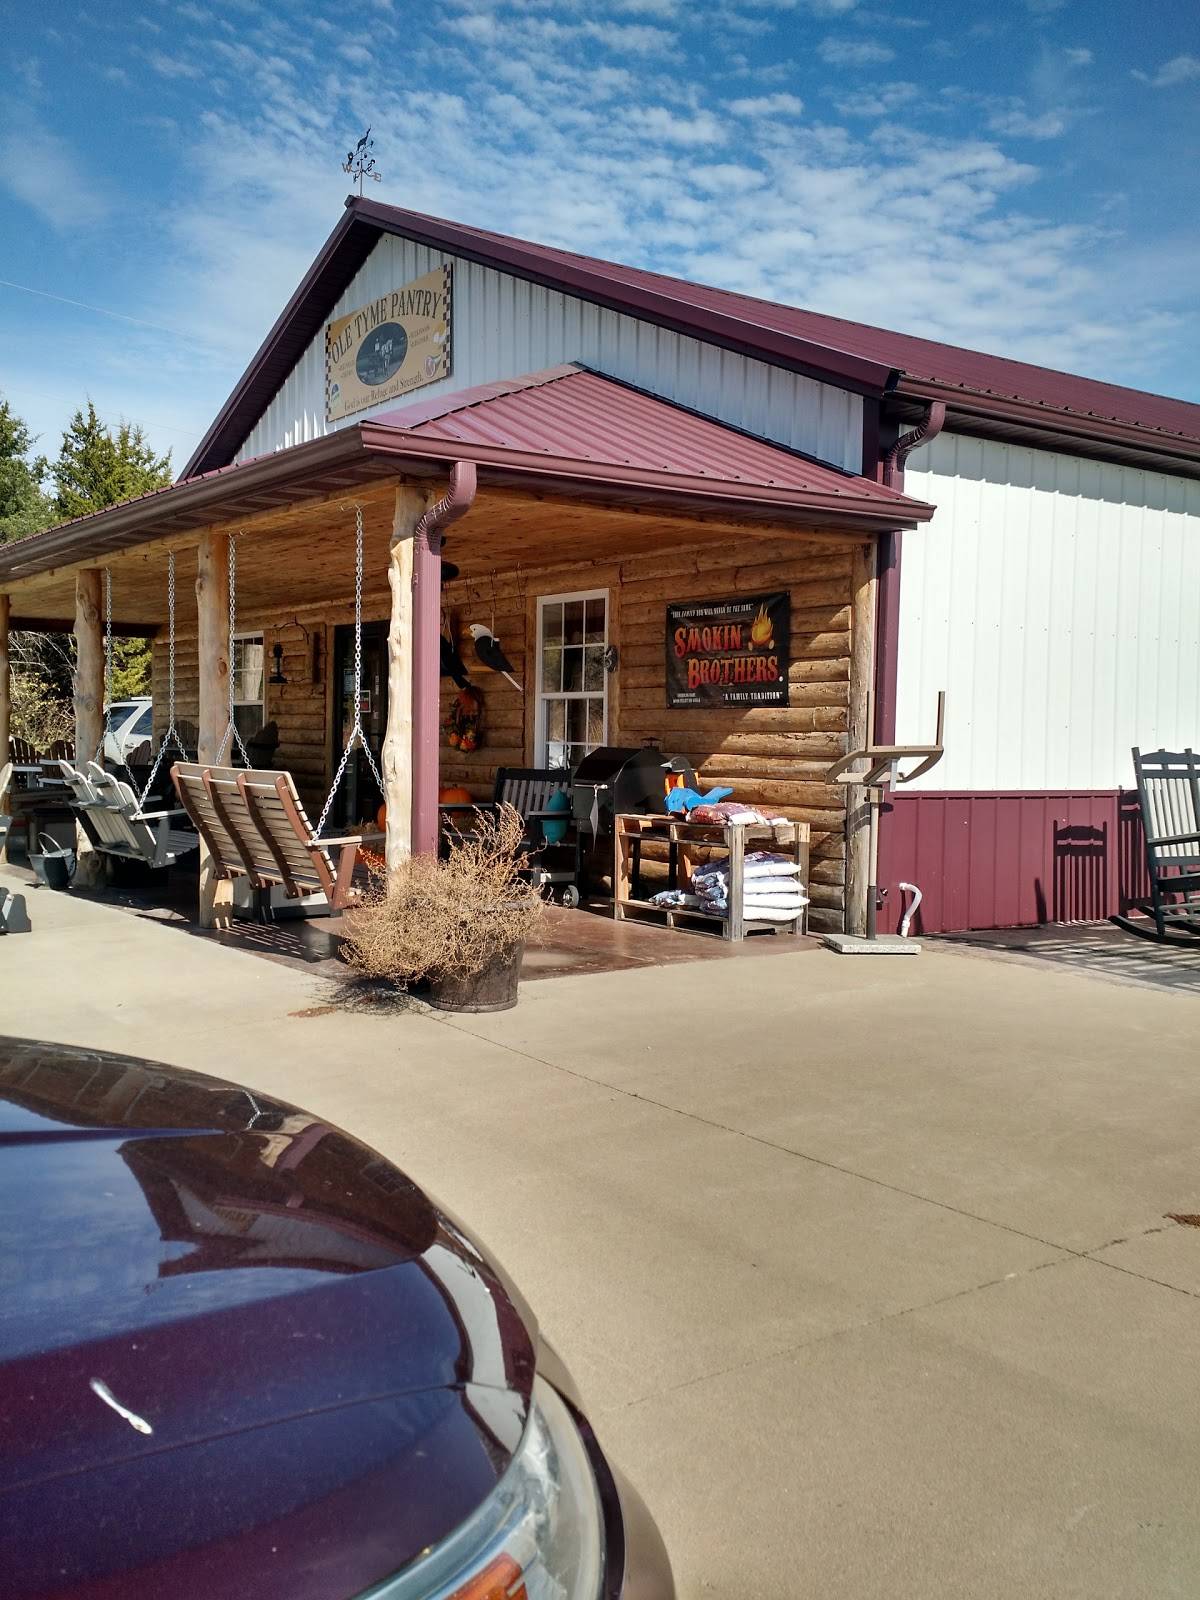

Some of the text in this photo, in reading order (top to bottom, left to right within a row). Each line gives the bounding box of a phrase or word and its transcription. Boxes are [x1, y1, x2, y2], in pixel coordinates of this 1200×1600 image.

[331, 324, 353, 364] OLE
[355, 298, 387, 339] TYME
[391, 289, 442, 320] PANTRY
[674, 624, 743, 658] SMOKIN
[687, 655, 779, 689] BROTHERS
[730, 692, 749, 701] FAMILY
